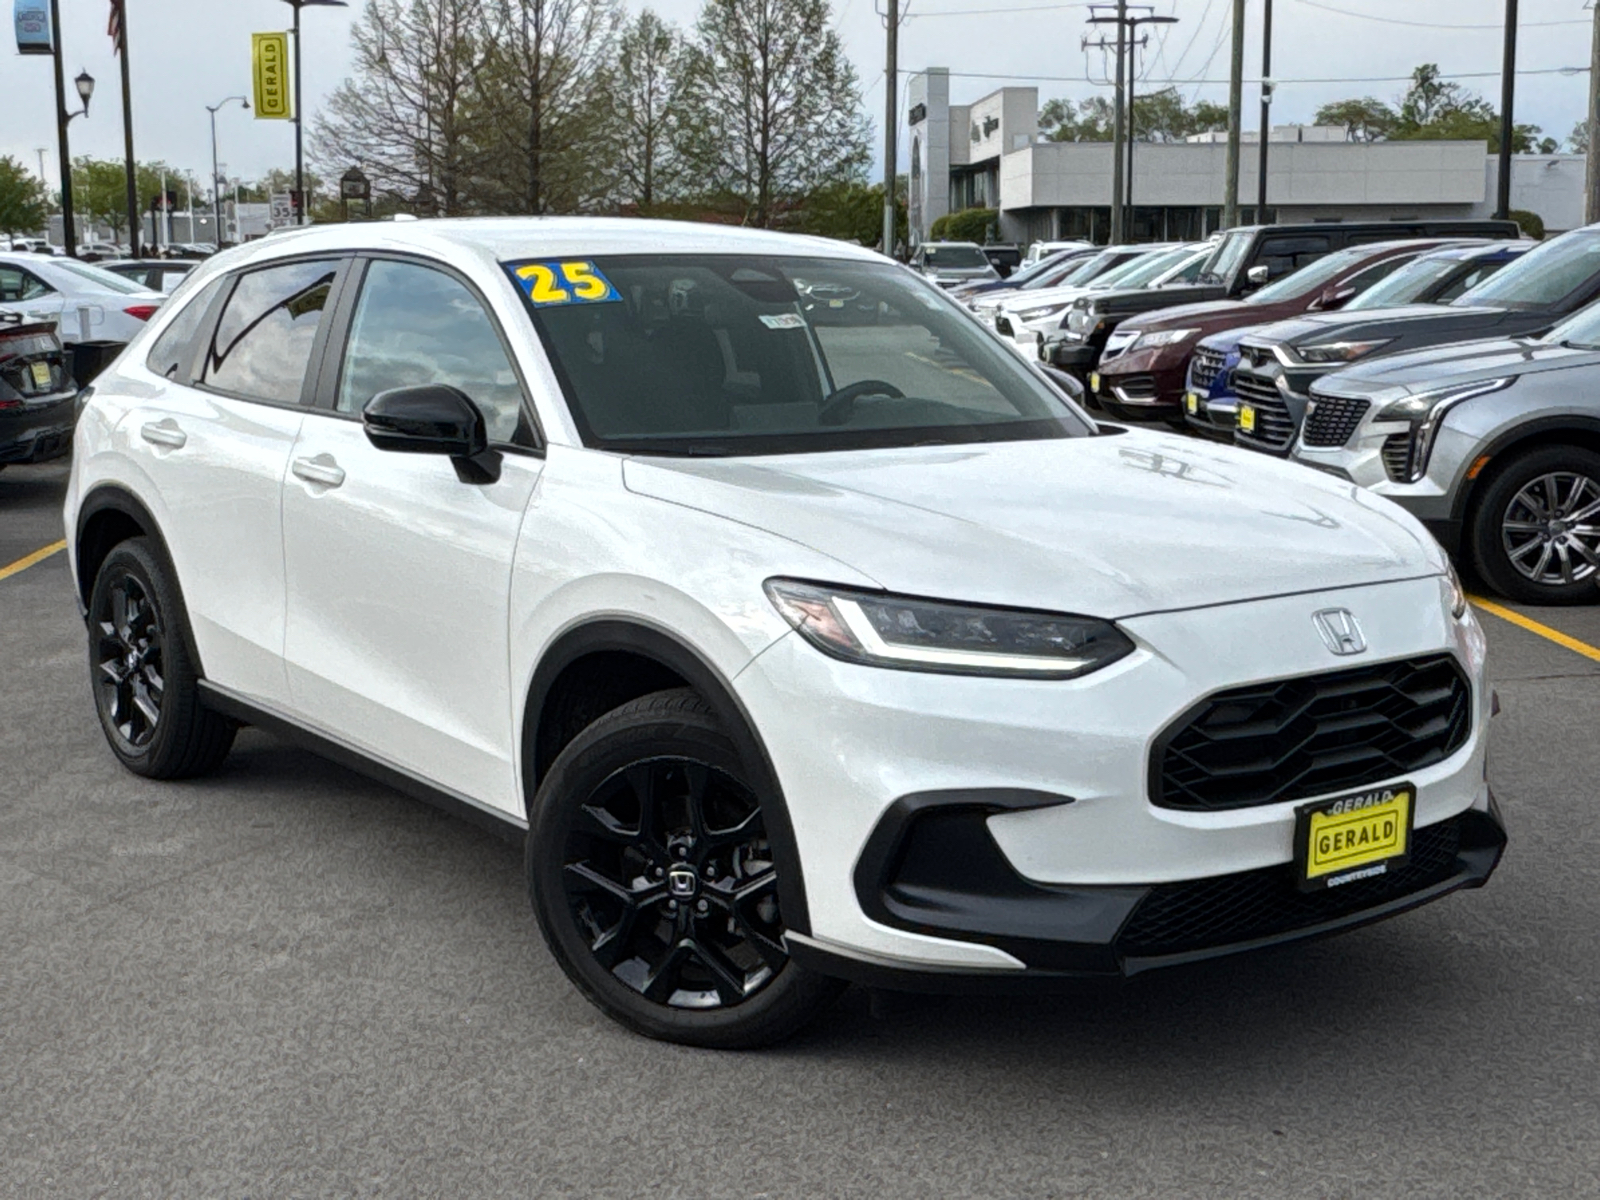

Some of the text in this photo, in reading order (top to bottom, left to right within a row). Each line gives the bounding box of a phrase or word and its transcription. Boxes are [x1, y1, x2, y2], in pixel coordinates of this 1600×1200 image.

[265, 44, 278, 108] GERALD
[274, 207, 290, 217] 35
[514, 263, 609, 303] 25
[1332, 790, 1392, 814] GERALD
[1319, 820, 1393, 855] GERALD
